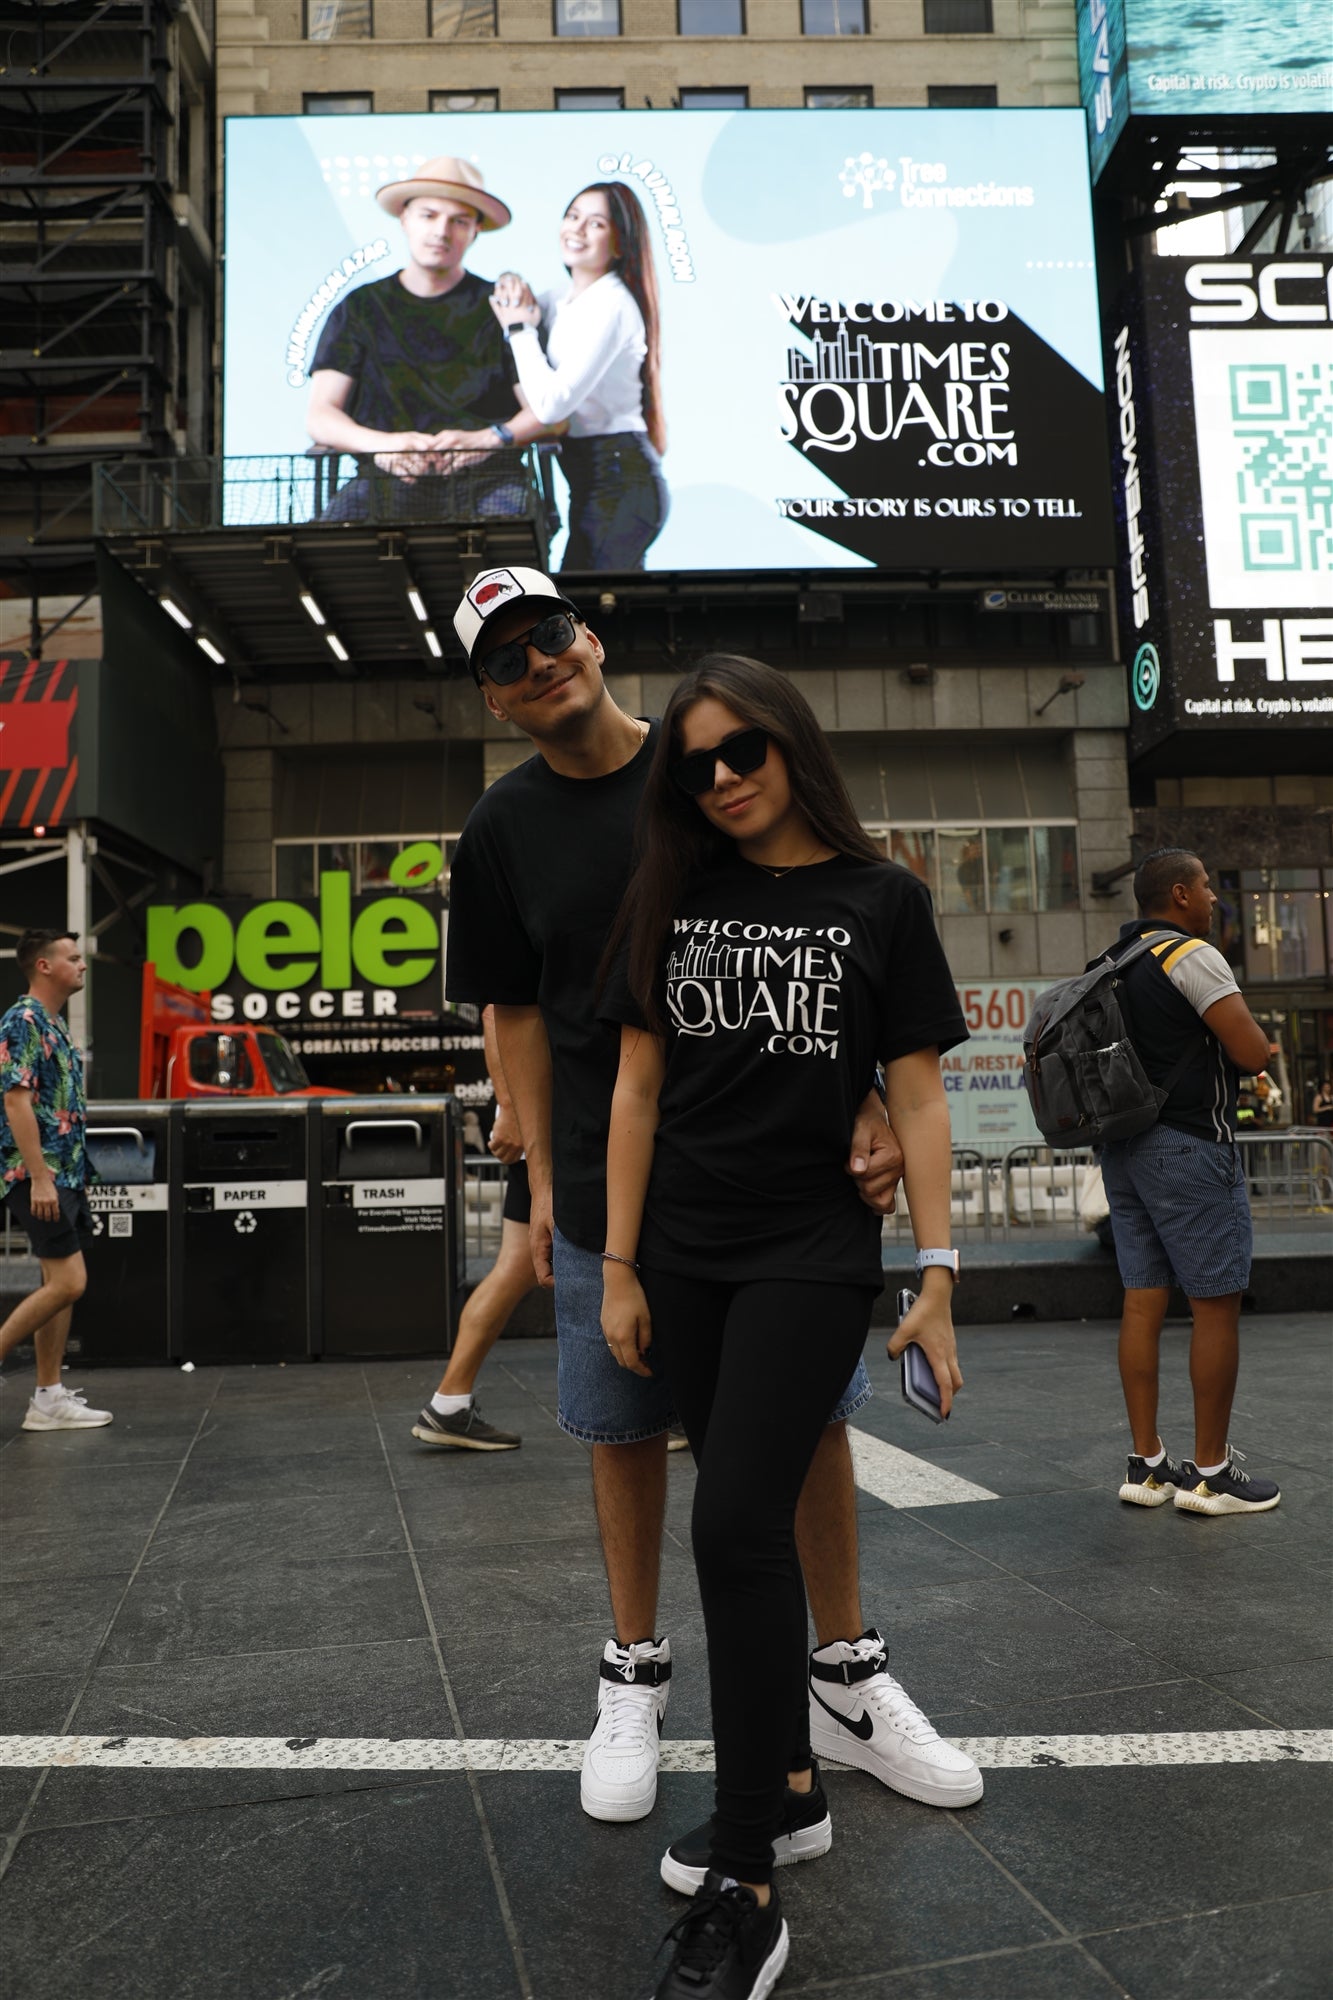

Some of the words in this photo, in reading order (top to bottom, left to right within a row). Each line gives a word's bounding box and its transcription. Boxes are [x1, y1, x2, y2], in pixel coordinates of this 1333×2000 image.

[1148, 73, 1190, 92] Capital
[1193, 74, 1206, 90] at
[1209, 73, 1235, 90] risk.
[1237, 72, 1276, 92] Crypto
[1280, 73, 1290, 89] is
[1292, 71, 1333, 88] volatil
[899, 156, 947, 183] Tree
[900, 181, 1035, 208] Connections
[1185, 262, 1333, 322] SC
[772, 294, 954, 323] WELCOME
[961, 299, 1009, 322] TO
[874, 342, 1011, 382] TIMES
[776, 382, 1015, 453] SQUARE
[917, 442, 1018, 467] .COM
[1114, 325, 1151, 629] SAFEMOON
[777, 498, 839, 518] YOUR
[842, 498, 909, 518] STORY
[913, 499, 931, 517] IS
[934, 498, 996, 518] OURS
[1001, 498, 1031, 517] TO
[1184, 698, 1221, 715] Capital
[1221, 698, 1233, 713] at
[1233, 697, 1257, 713] risk.
[1256, 697, 1291, 714] Crypto
[1291, 697, 1302, 713] is
[146, 841, 444, 992] pelé
[673, 919, 810, 941] WELCOME
[816, 926, 851, 946] O
[731, 946, 844, 982] TIMES
[211, 990, 397, 1020] SOCCER
[666, 979, 841, 1037] SQUARE
[957, 988, 1025, 1031] 560
[302, 1038, 379, 1055] GREATEST
[381, 1036, 441, 1052] SOCCER
[760, 1034, 838, 1060] .COM
[119, 1185, 129, 1196] &
[224, 1190, 266, 1201] PAPER
[362, 1188, 405, 1199] TRASH
[89, 1200, 134, 1209] OTTLES
